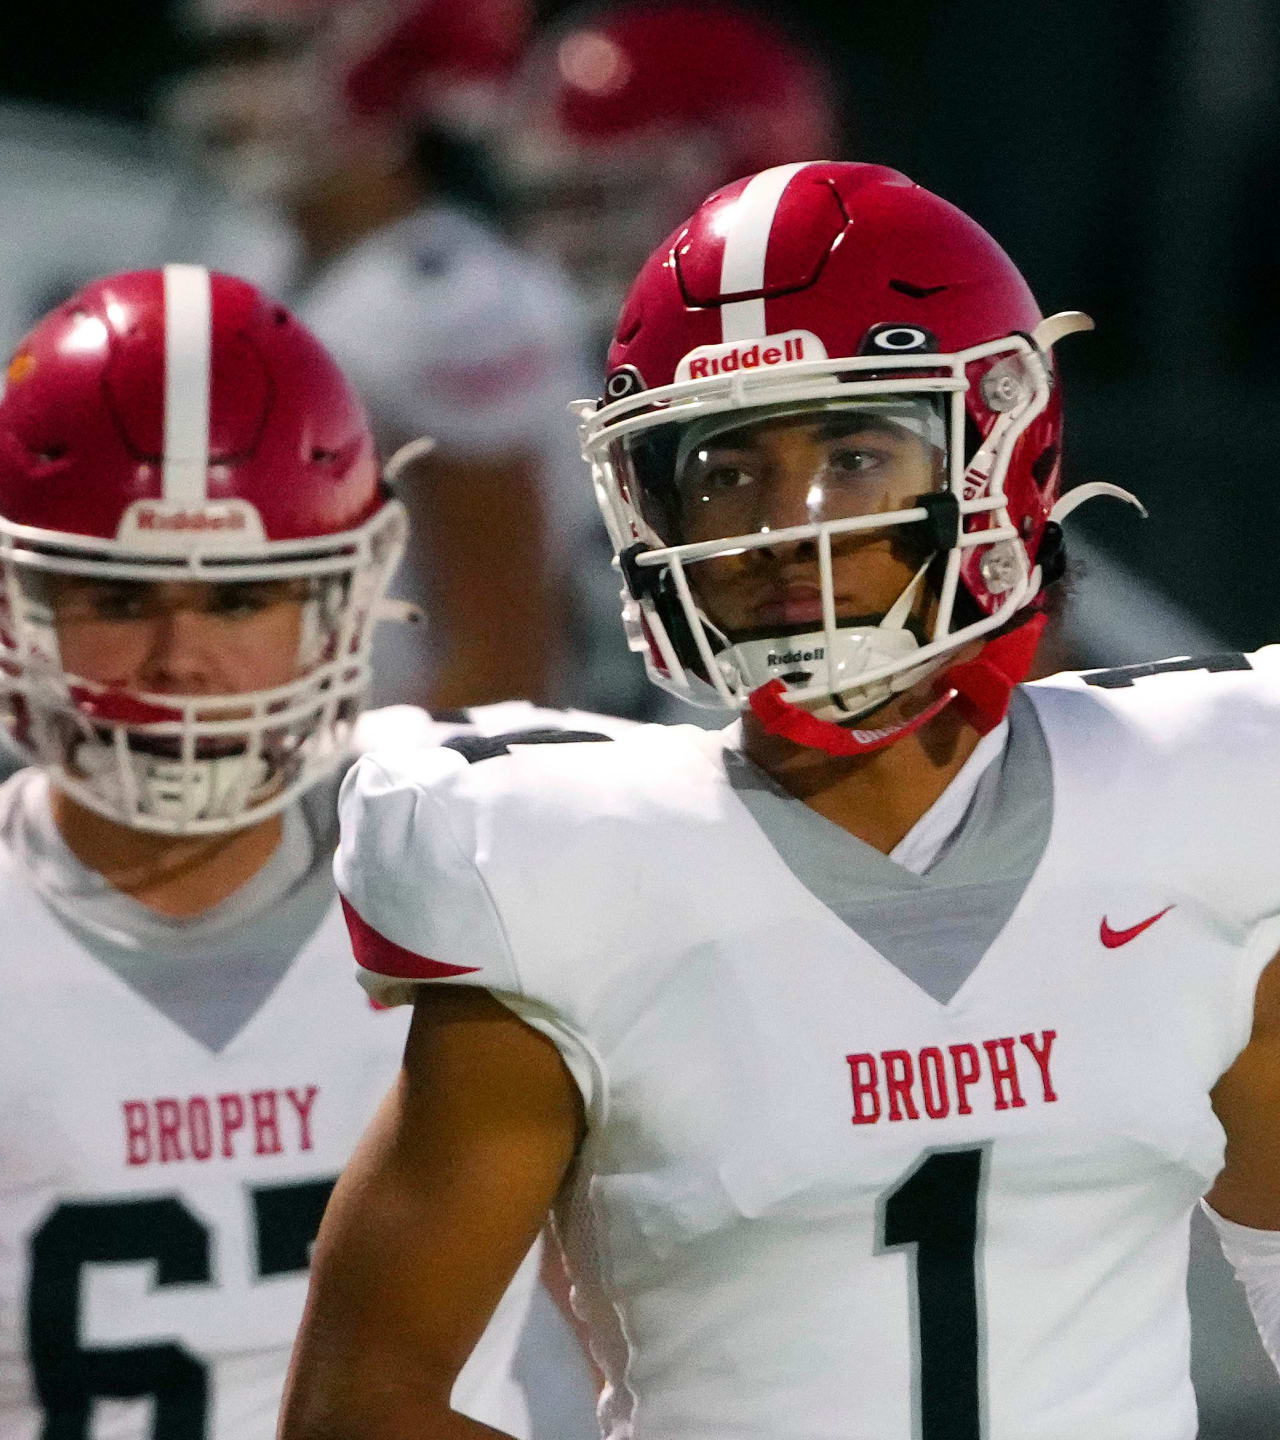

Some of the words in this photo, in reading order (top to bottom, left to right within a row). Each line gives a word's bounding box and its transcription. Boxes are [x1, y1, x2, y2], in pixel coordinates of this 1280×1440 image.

[689, 337, 804, 380] Riddell
[846, 1030, 1058, 1124] BROPHY
[123, 1083, 320, 1166] BROPHY
